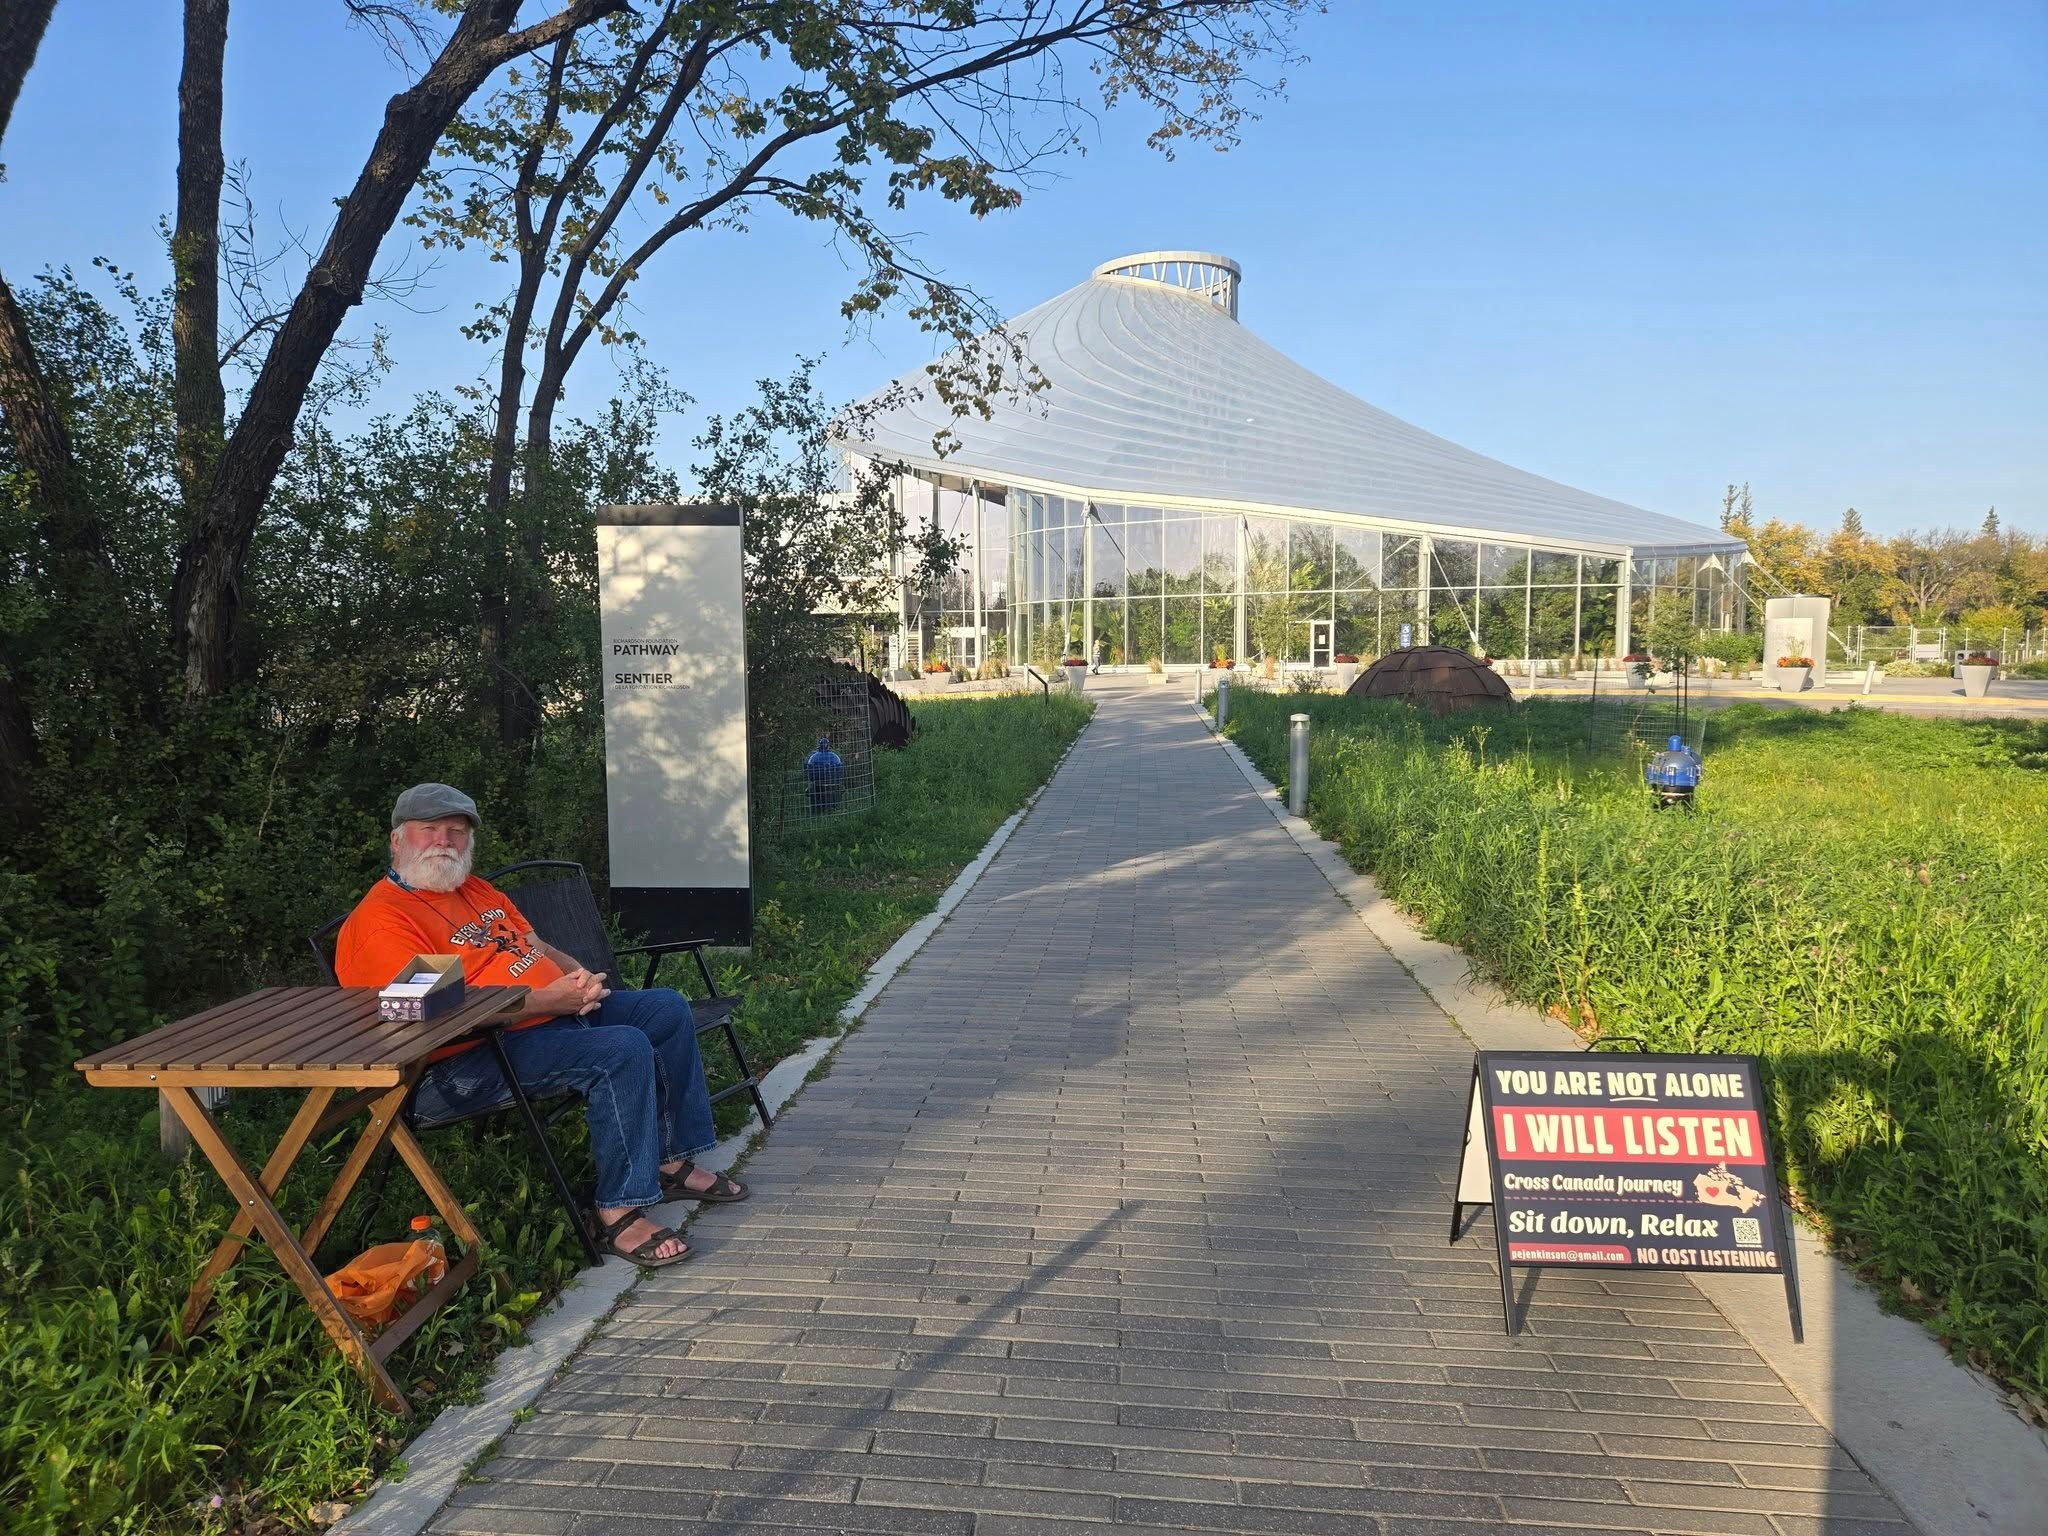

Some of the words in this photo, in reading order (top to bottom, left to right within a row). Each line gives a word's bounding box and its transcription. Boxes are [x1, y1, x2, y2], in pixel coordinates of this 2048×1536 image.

[613, 644, 679, 656] PATHWAY
[615, 673, 673, 684] SENTIER
[1495, 1070, 1547, 1095] YOU
[1554, 1071, 1603, 1096] ARE
[1606, 1071, 1657, 1097] NOT
[1665, 1072, 1745, 1098] ALONE
[1502, 1113, 1517, 1153] I
[1524, 1114, 1614, 1155] WILL
[1622, 1115, 1753, 1158] LISTEN
[1504, 1172, 1550, 1191] Cross
[1552, 1174, 1615, 1193] Canada
[1616, 1175, 1684, 1198] Journey
[1508, 1209, 1546, 1233] Sit
[1550, 1210, 1635, 1239] down,
[1640, 1213, 1719, 1238] Relax
[1636, 1247, 1659, 1265] NO
[1661, 1248, 1698, 1266] COST
[1701, 1249, 1778, 1268] LISTENING
